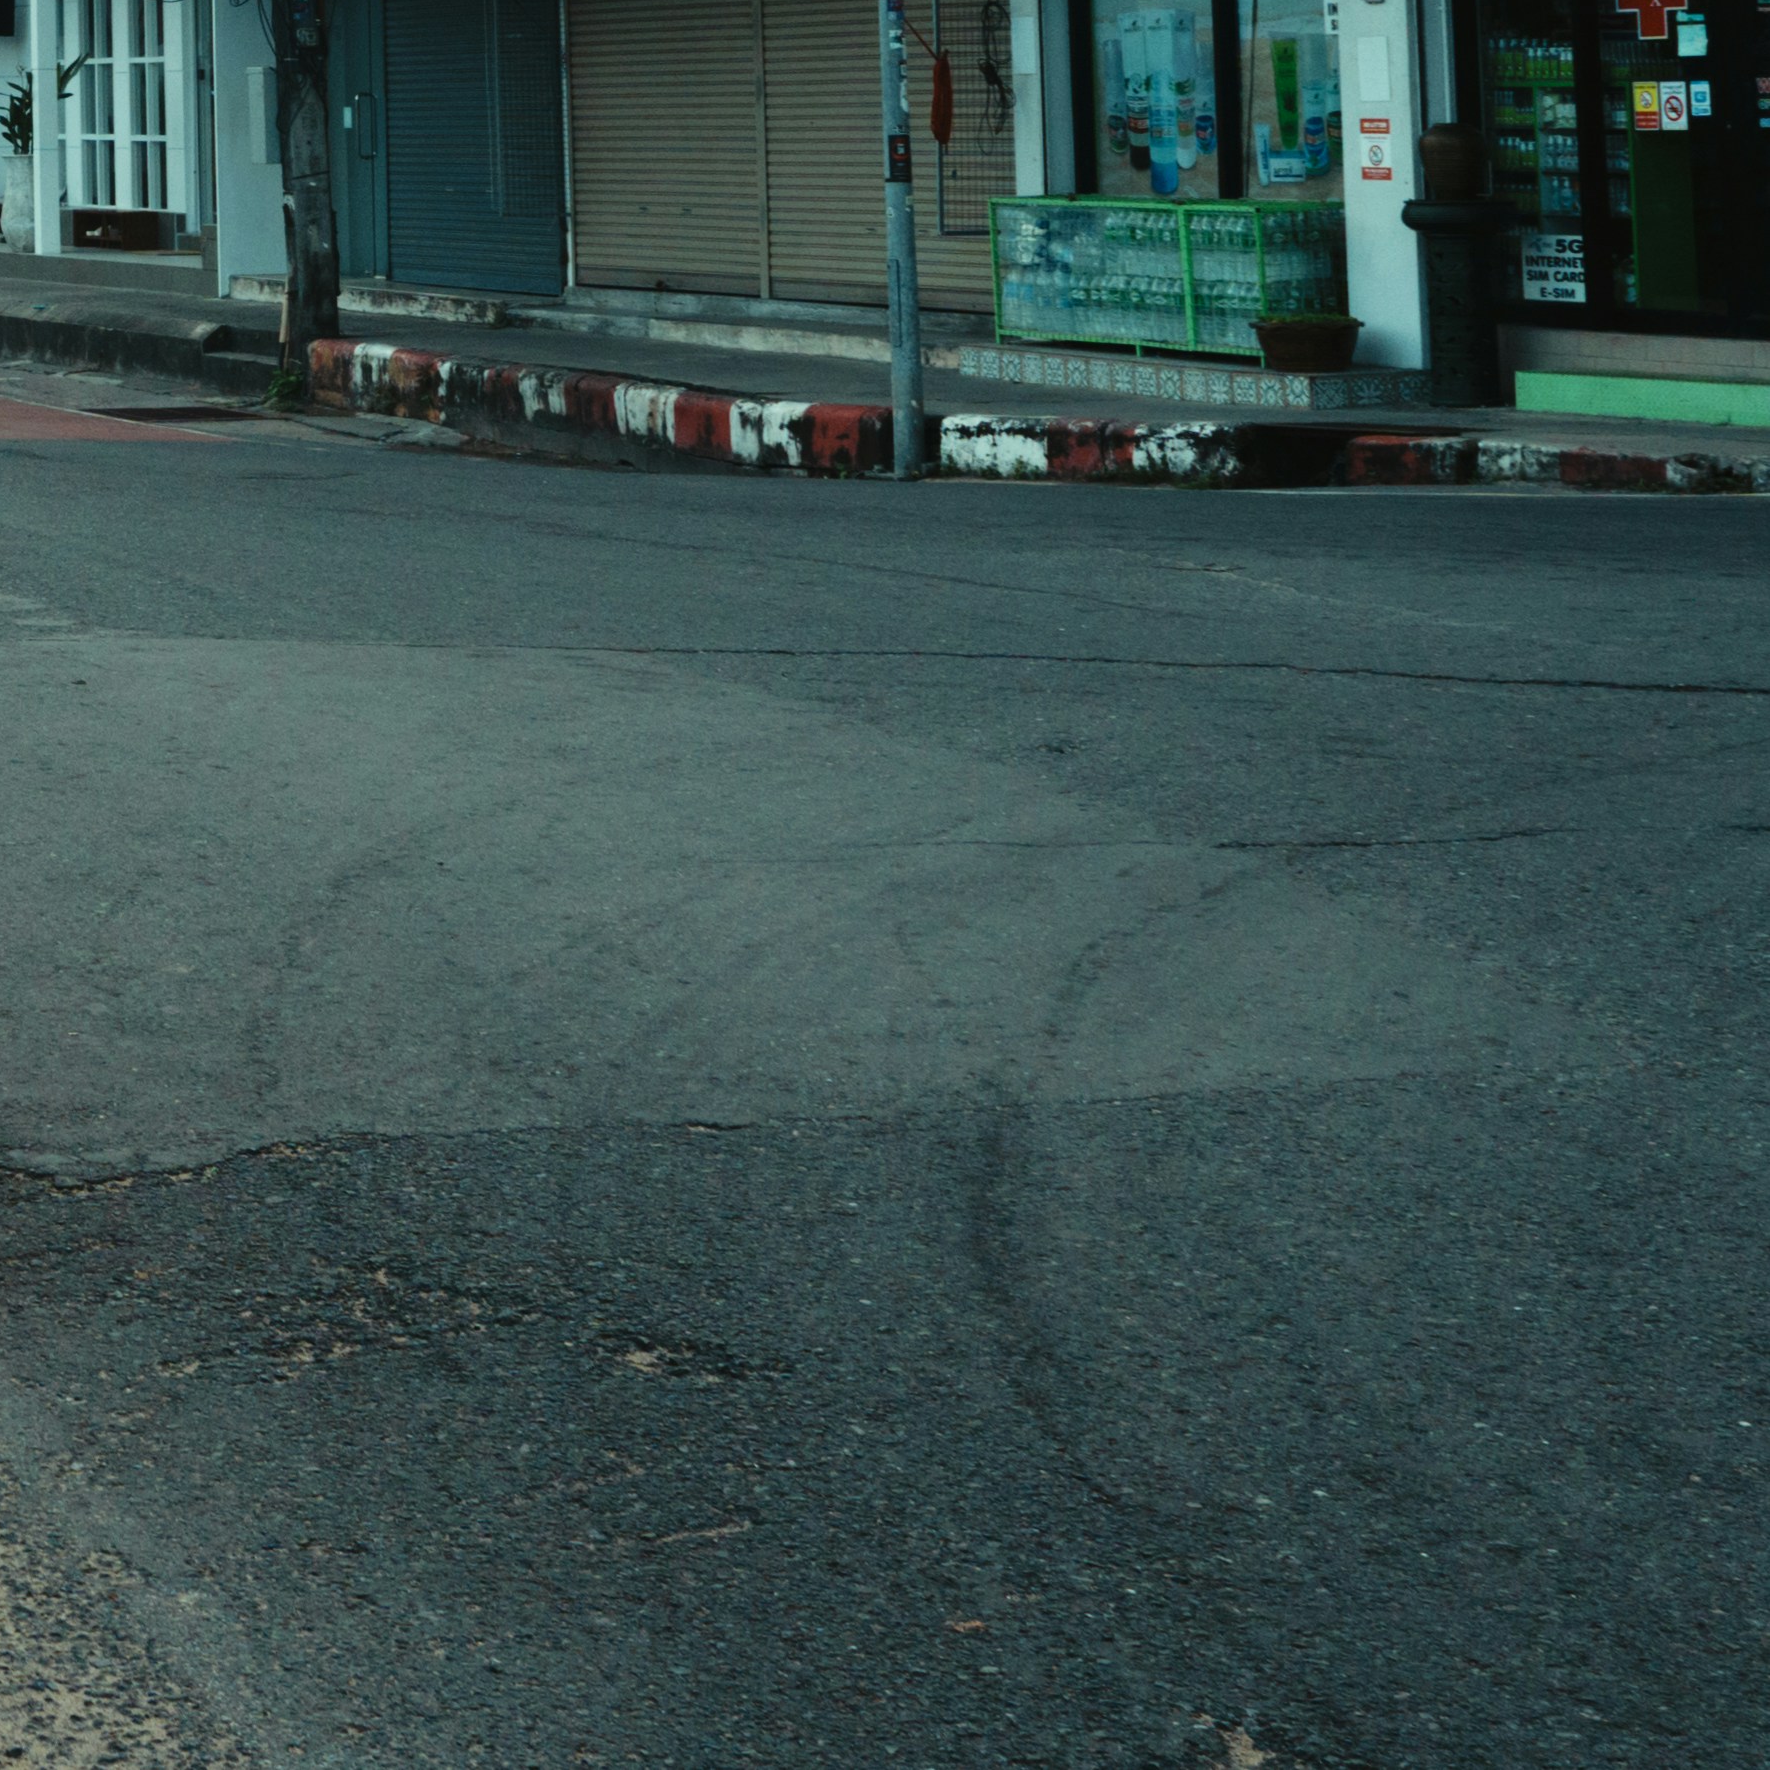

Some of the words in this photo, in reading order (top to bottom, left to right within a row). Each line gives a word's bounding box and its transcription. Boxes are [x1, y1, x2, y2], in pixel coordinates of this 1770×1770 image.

[1554, 238, 1583, 254] 5G
[1525, 255, 1586, 269] INTERNET
[1526, 270, 1550, 281] SIM
[1553, 270, 1586, 283] CARD
[1540, 287, 1576, 299] E-SIM
